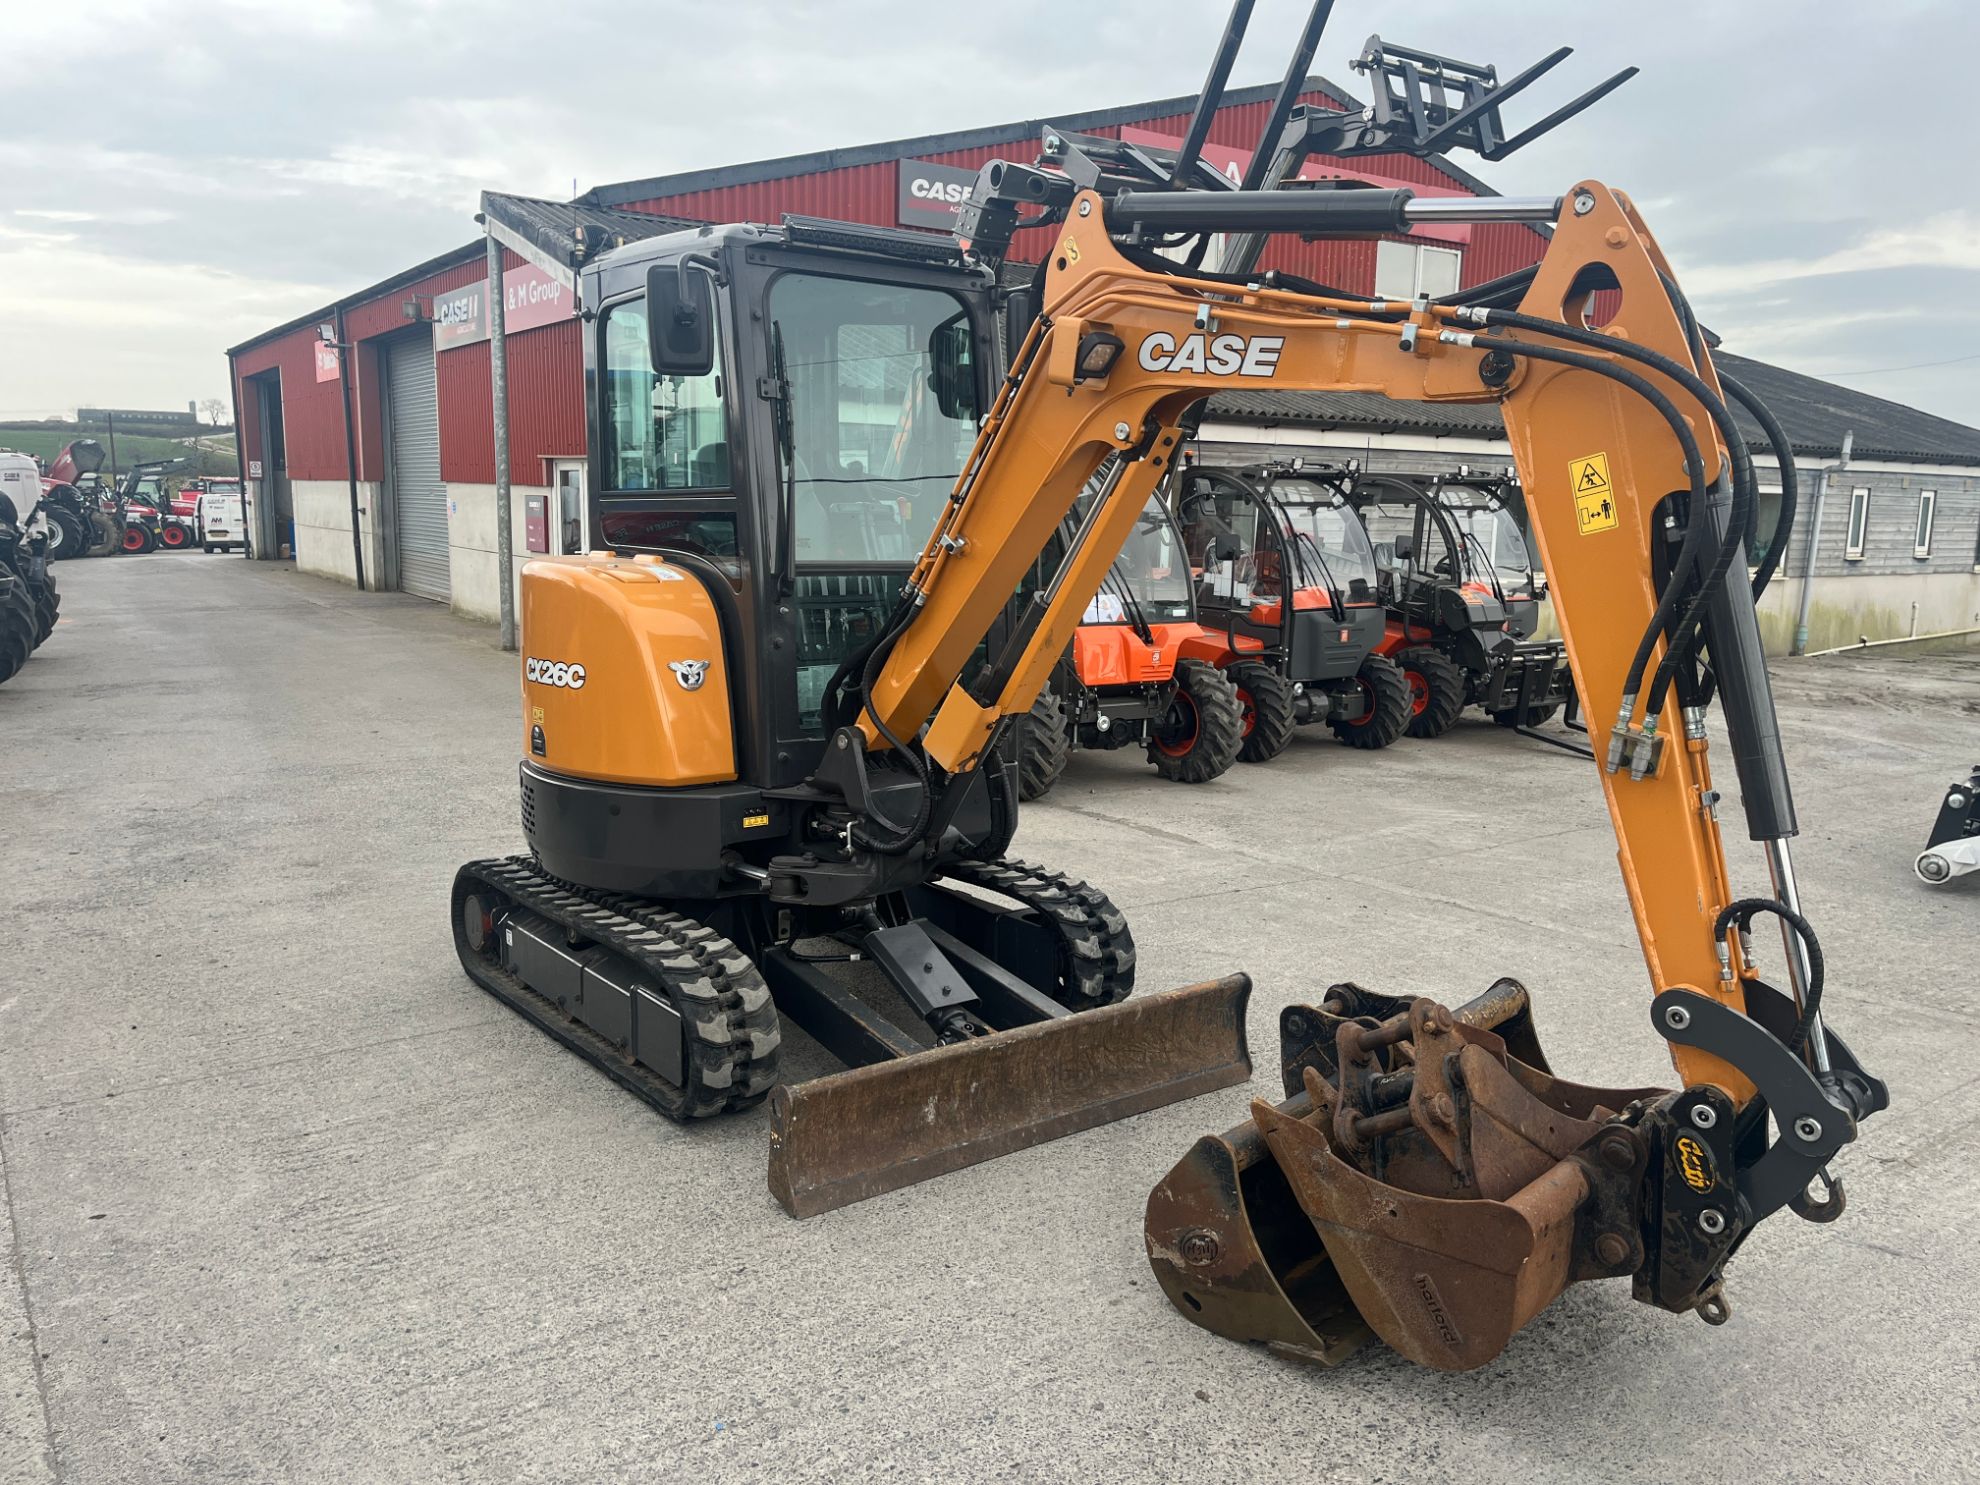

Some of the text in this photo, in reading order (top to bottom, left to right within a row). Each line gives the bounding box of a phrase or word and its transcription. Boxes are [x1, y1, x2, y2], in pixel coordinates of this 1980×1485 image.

[508, 279, 561, 311] & M Group
[1137, 331, 1286, 378] CASE
[526, 656, 586, 690] CX26C
